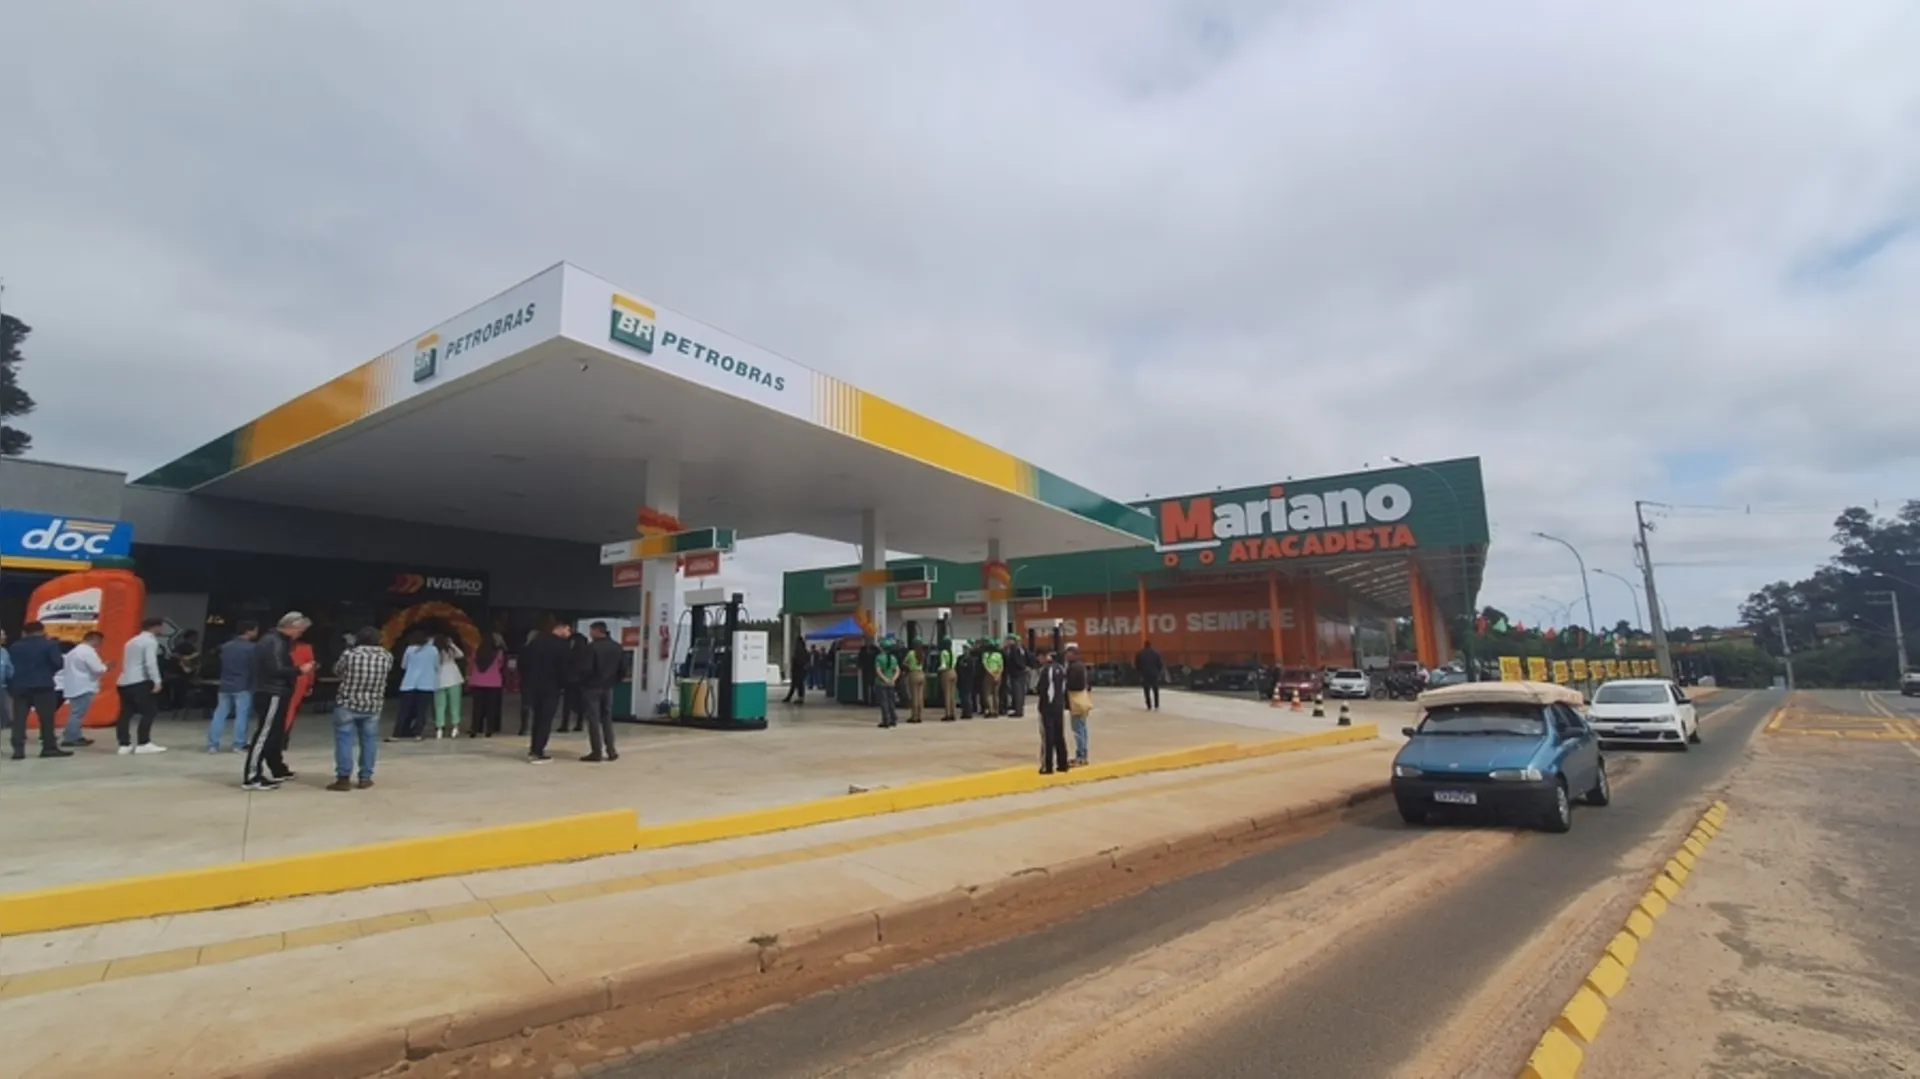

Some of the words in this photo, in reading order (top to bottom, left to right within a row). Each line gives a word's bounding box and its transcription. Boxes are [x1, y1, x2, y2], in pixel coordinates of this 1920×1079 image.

[445, 302, 536, 360] PETROBRAS
[617, 312, 652, 342] BR
[661, 330, 786, 392] PETROBRAS
[21, 518, 111, 554] doc
[1160, 483, 1412, 544] Mariano
[1228, 523, 1417, 563] ATACADISTA
[1085, 613, 1177, 636] BARATO
[1185, 608, 1296, 632] SEMPRE
